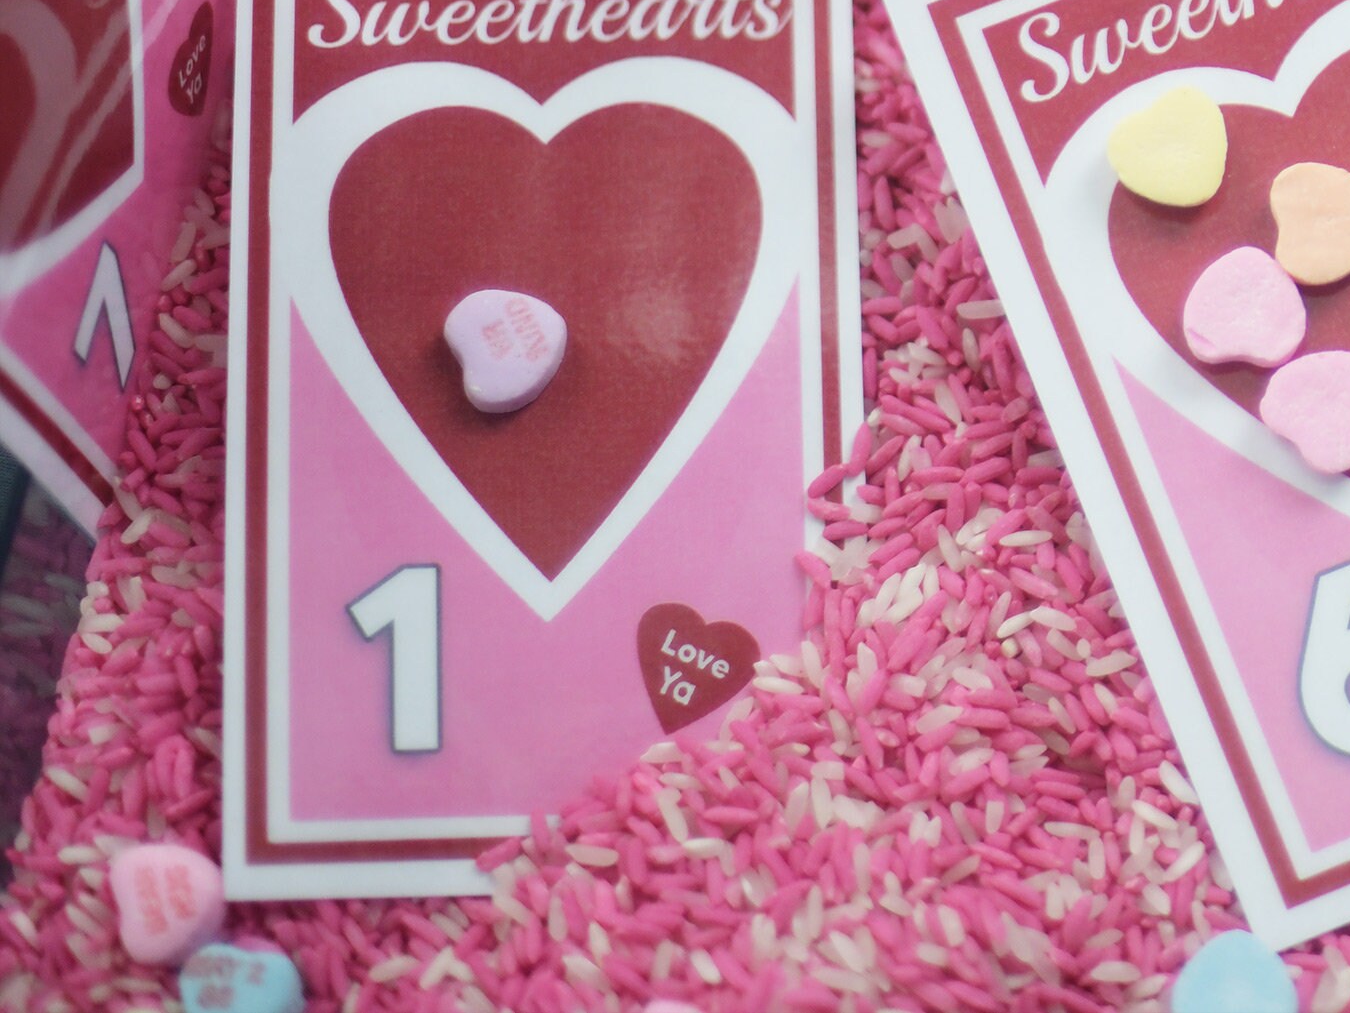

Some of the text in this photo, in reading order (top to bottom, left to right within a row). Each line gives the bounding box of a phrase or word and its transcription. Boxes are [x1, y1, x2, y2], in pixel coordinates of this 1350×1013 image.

[179, 34, 206, 89] Love
[345, 563, 443, 754] 1
[660, 627, 731, 680] Love
[660, 665, 697, 706] Ya
